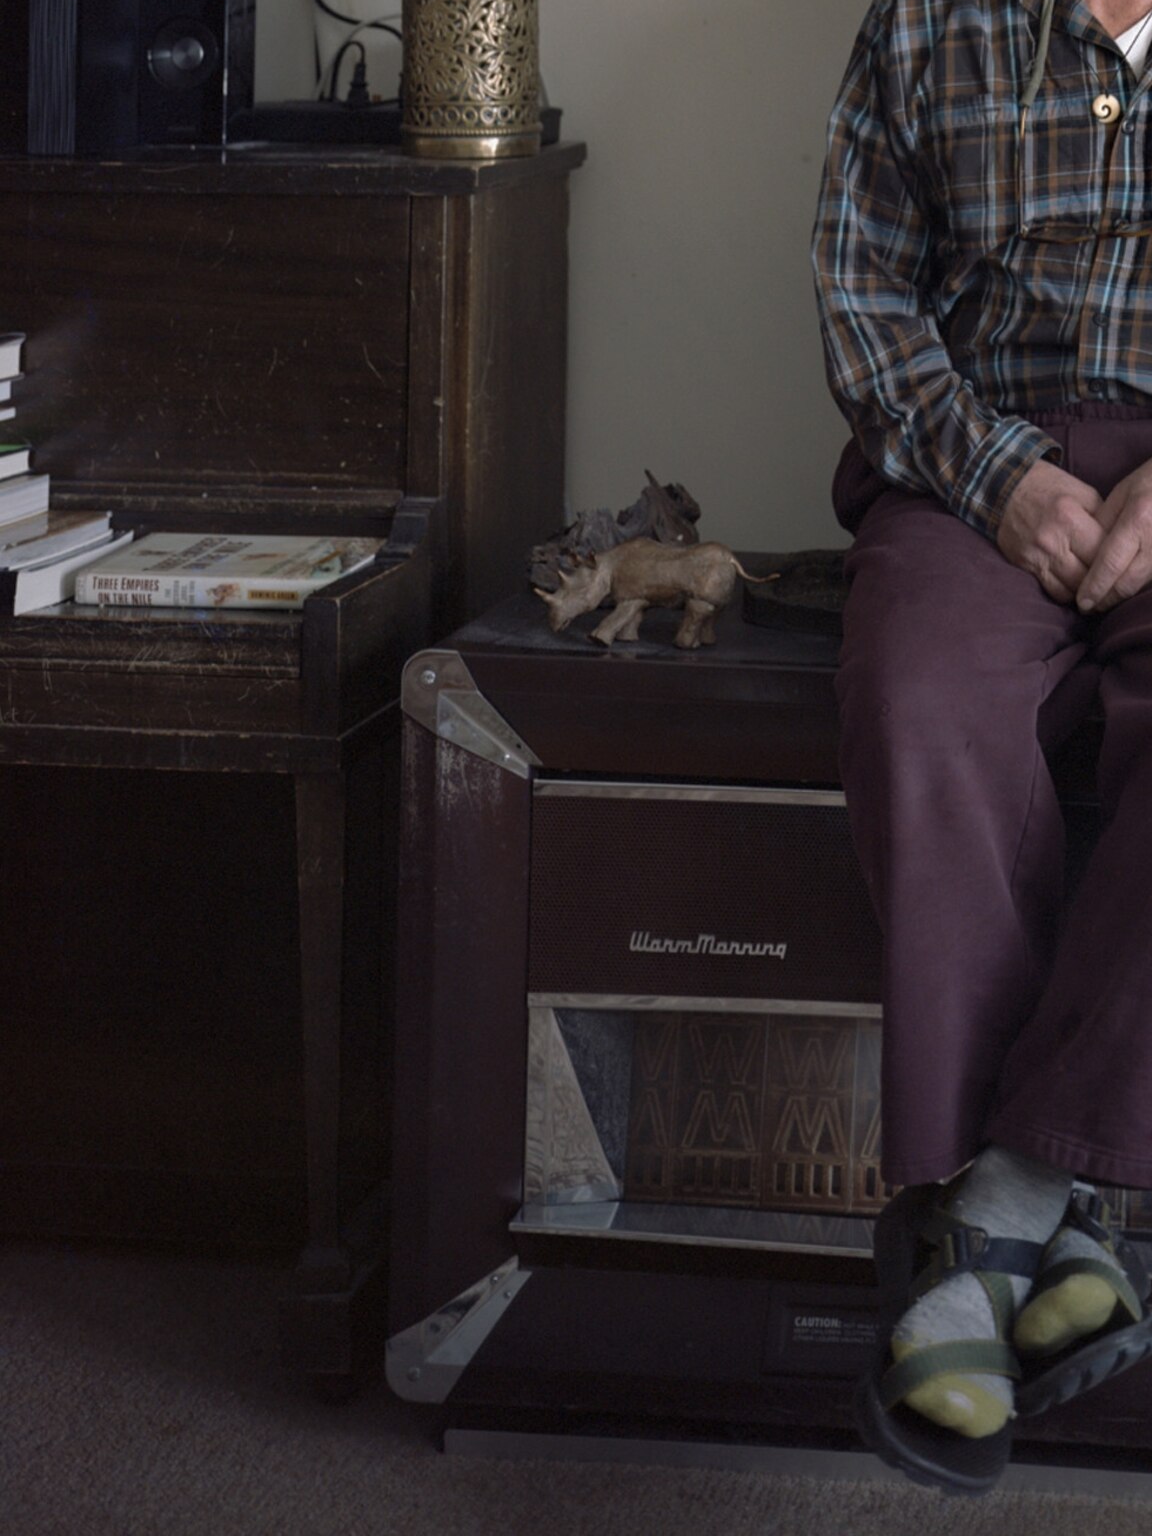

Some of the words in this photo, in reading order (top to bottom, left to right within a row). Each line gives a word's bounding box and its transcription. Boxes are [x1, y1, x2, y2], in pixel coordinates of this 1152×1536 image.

[92, 575, 119, 592] THREE
[120, 576, 160, 592] EMPIRES
[110, 592, 128, 605] THE
[131, 592, 152, 605] NILE
[794, 1315, 842, 1328] CAUTION:
